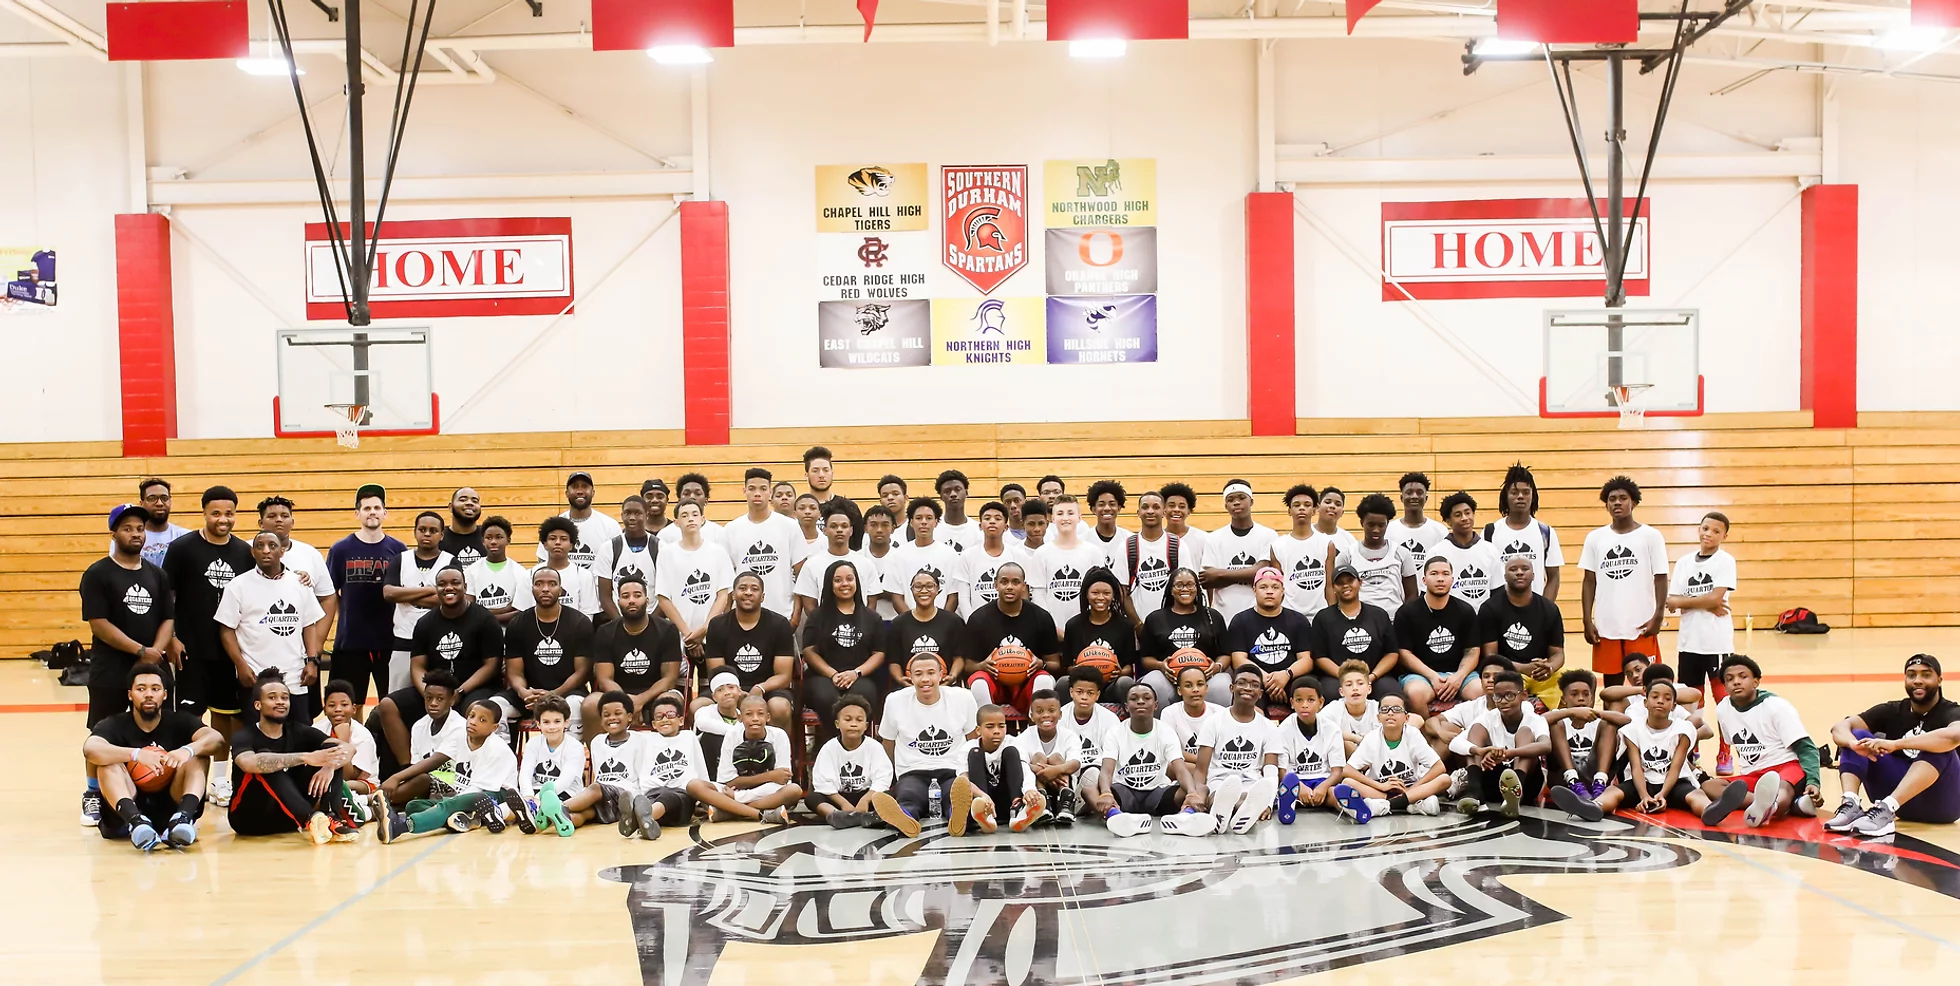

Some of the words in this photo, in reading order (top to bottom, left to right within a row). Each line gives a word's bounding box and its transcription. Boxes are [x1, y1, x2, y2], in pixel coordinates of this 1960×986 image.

[947, 171, 1021, 198] SOUTHERN
[948, 188, 1021, 218] DURHAM
[1052, 201, 1117, 213] NORTHWOOD
[1124, 200, 1149, 212] HIGH
[823, 207, 862, 218] CHAPEL
[869, 206, 890, 217] HILL
[897, 205, 921, 216] HIGH
[855, 219, 891, 230] TIGERS
[1073, 214, 1128, 225] CHARGERS
[1430, 231, 1604, 269] HOME
[949, 242, 1022, 273] SPARTANS
[823, 275, 857, 286] CEDAR
[864, 274, 894, 285] RIDGE
[900, 273, 925, 284] HIGH
[1112, 269, 1139, 281] HIGH
[841, 288, 860, 299] RED
[867, 287, 908, 298] WOLVES
[1074, 281, 1129, 293] PANTHERS
[824, 339, 850, 350] EAST
[902, 337, 924, 349] HILL
[946, 341, 1000, 351] NORTHERN
[1006, 340, 1031, 350] HIGH
[1064, 338, 1109, 350] HILLSIDE
[1114, 338, 1140, 349] HIGH
[848, 352, 900, 364] WILDCATS
[966, 353, 1011, 363] KNIGHTS
[1079, 350, 1126, 362] HORNETS
[999, 648, 1026, 656] Wilson
[1083, 650, 1110, 658] Wilson
[1178, 655, 1205, 664] Wilson
